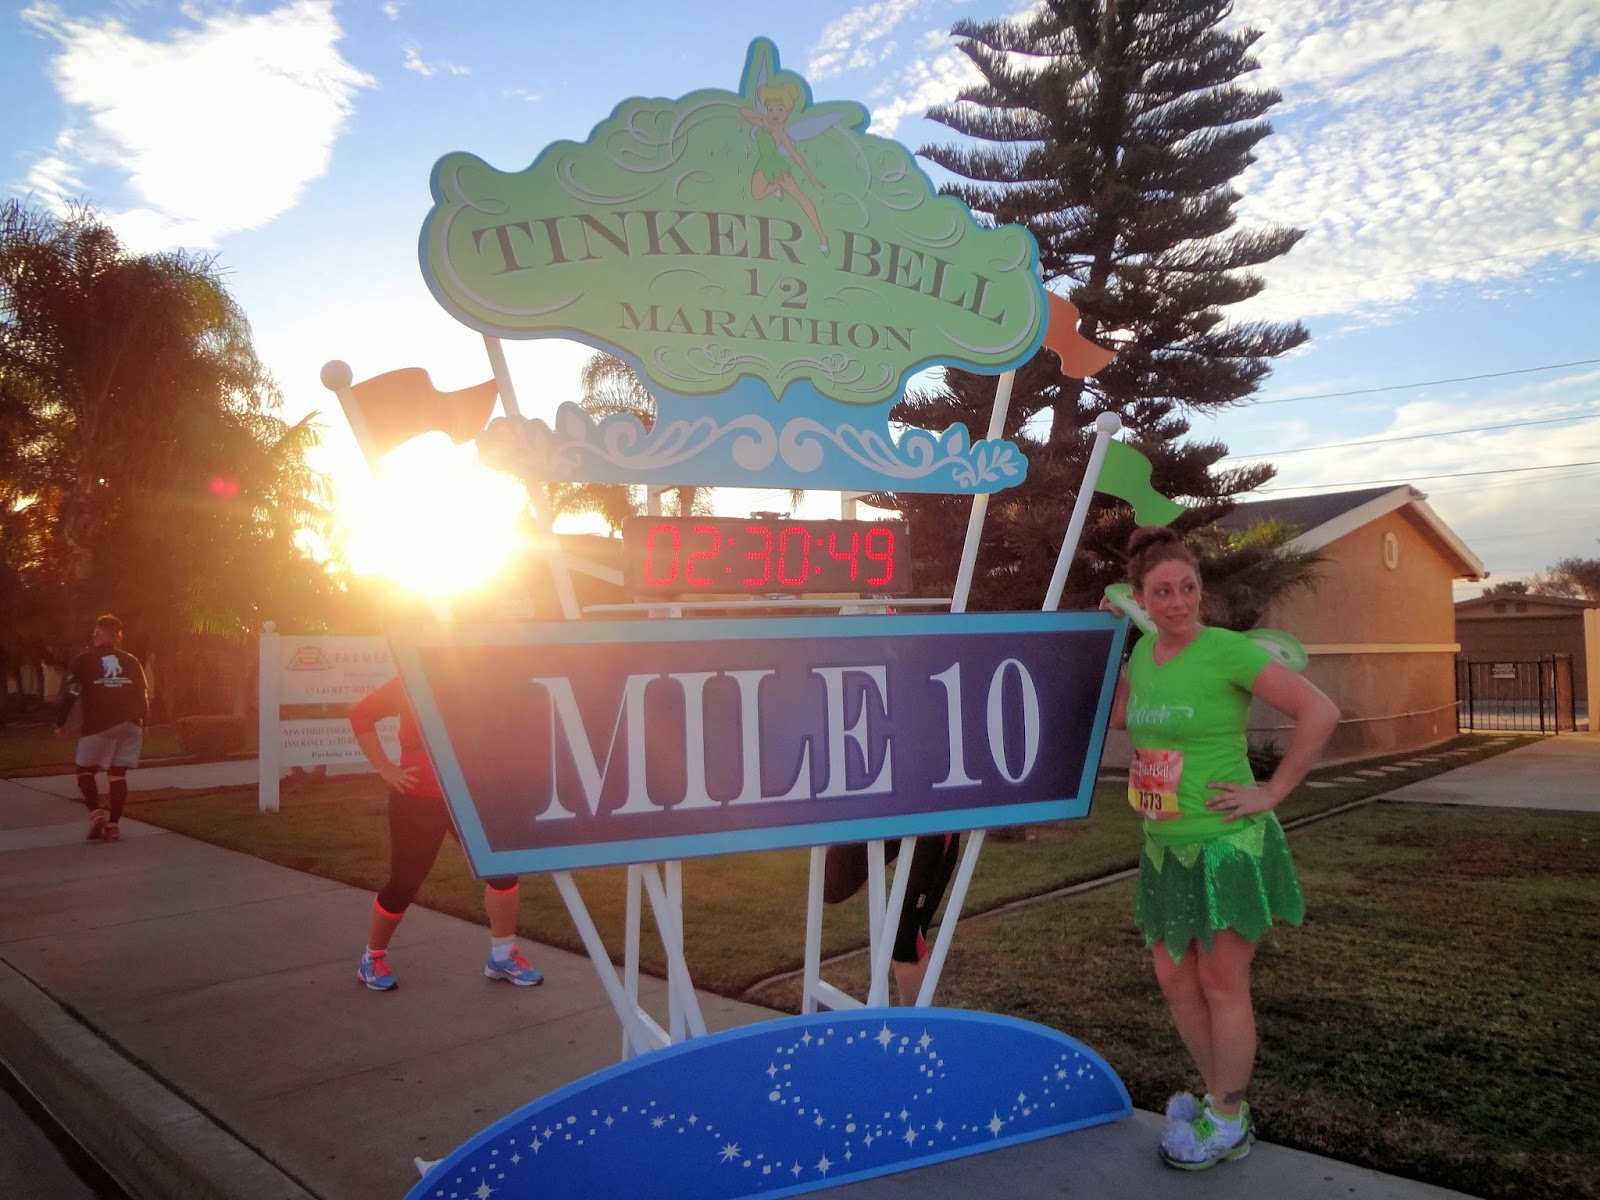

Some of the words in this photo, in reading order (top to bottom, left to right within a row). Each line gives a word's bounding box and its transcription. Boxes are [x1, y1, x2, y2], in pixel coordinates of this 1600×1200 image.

[472, 210, 806, 276] TINKER
[834, 227, 1007, 325] BELL
[616, 300, 914, 353] MARATHON
[643, 524, 895, 587] 02:30:49
[532, 665, 894, 822] MILE
[929, 657, 1040, 790] 10
